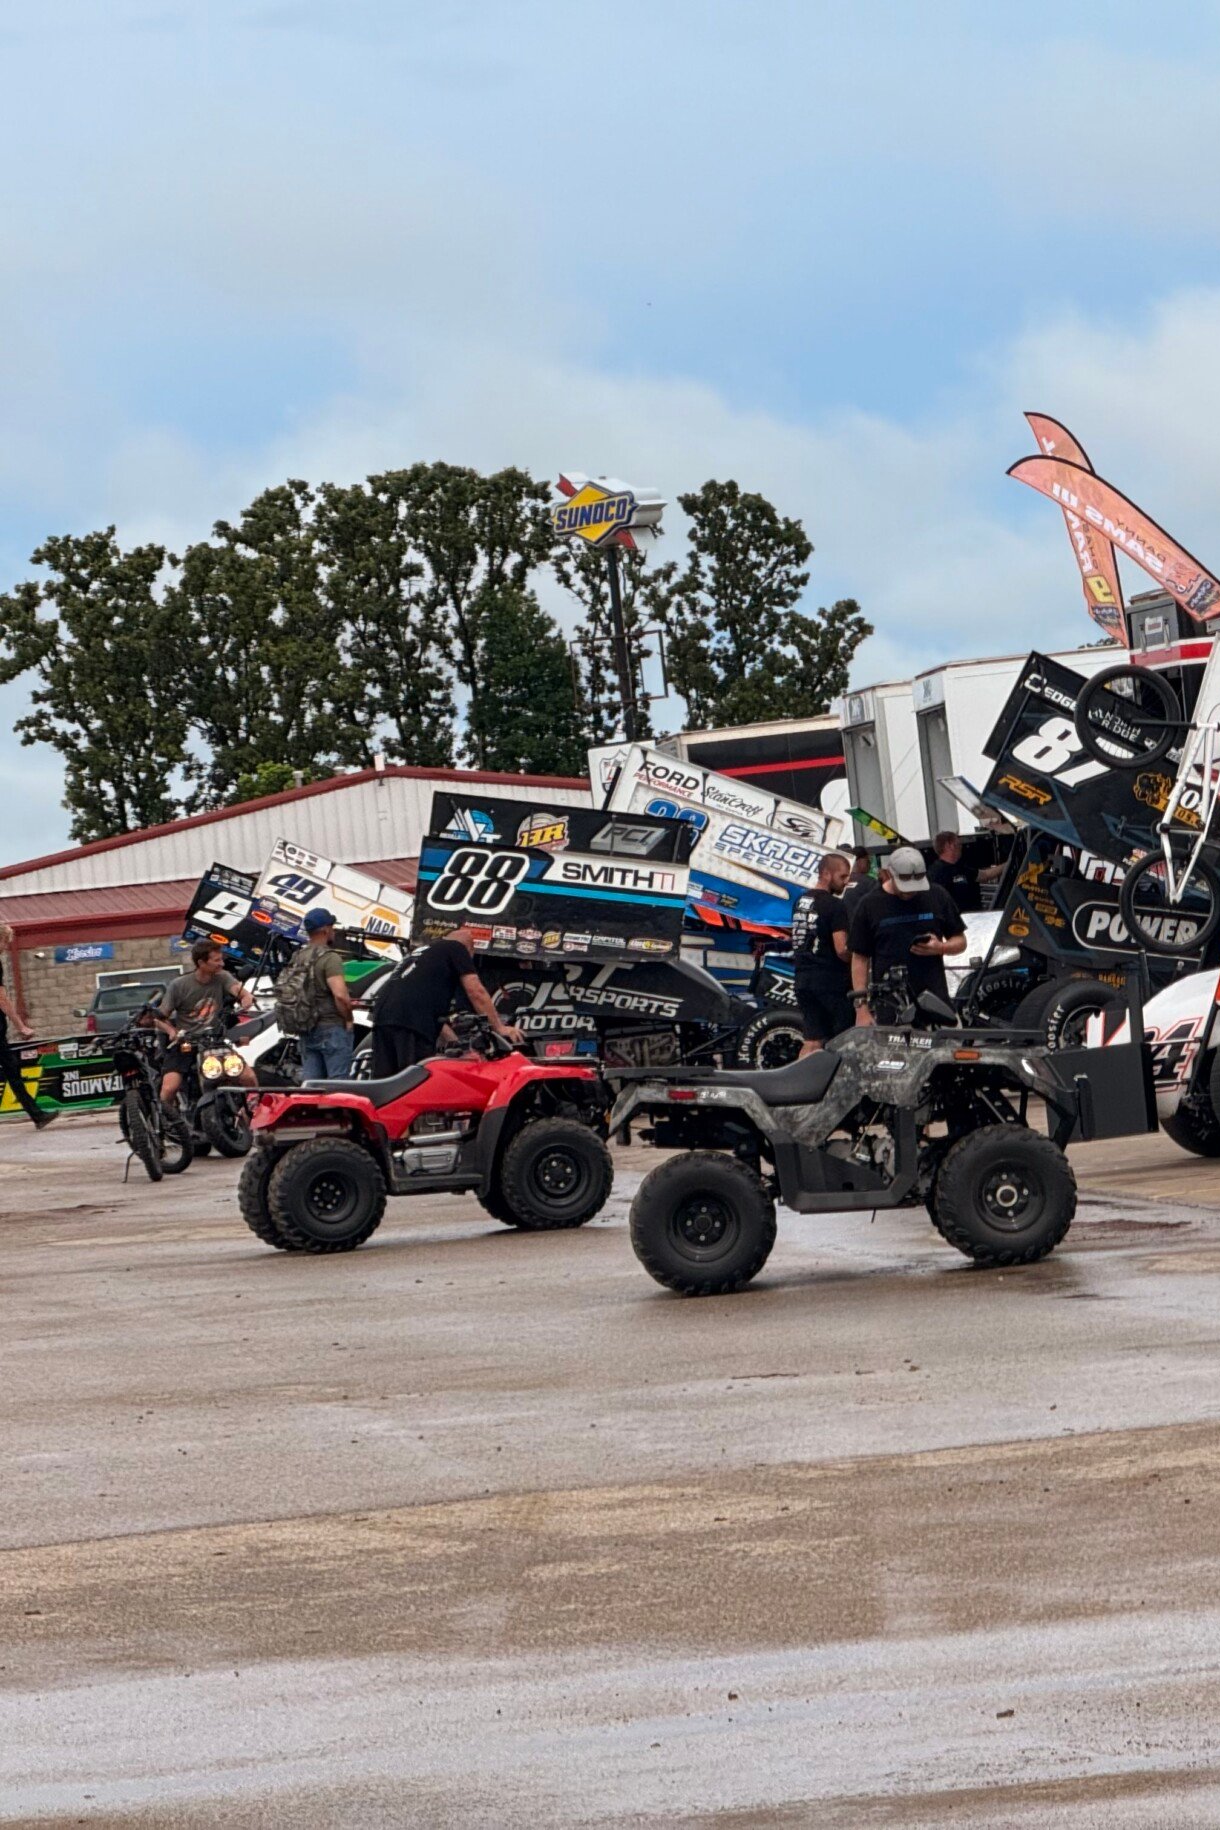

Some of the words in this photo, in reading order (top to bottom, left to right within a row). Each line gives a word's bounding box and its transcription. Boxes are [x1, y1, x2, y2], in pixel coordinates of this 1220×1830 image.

[556, 498, 628, 531] SUNOCO
[633, 771, 695, 799] PERFORMANCE
[640, 761, 700, 791] FORD
[998, 774, 1052, 806] RSR
[718, 825, 821, 874] SKAGI
[267, 873, 326, 905] 49
[427, 848, 530, 915] 88
[192, 890, 253, 930] 9
[366, 916, 398, 936] NAPA
[738, 1016, 768, 1064] Hoosier
[888, 1034, 932, 1047] TRAKER
[1047, 1003, 1065, 1053] oosier
[62, 1074, 125, 1098] FAMOUS
